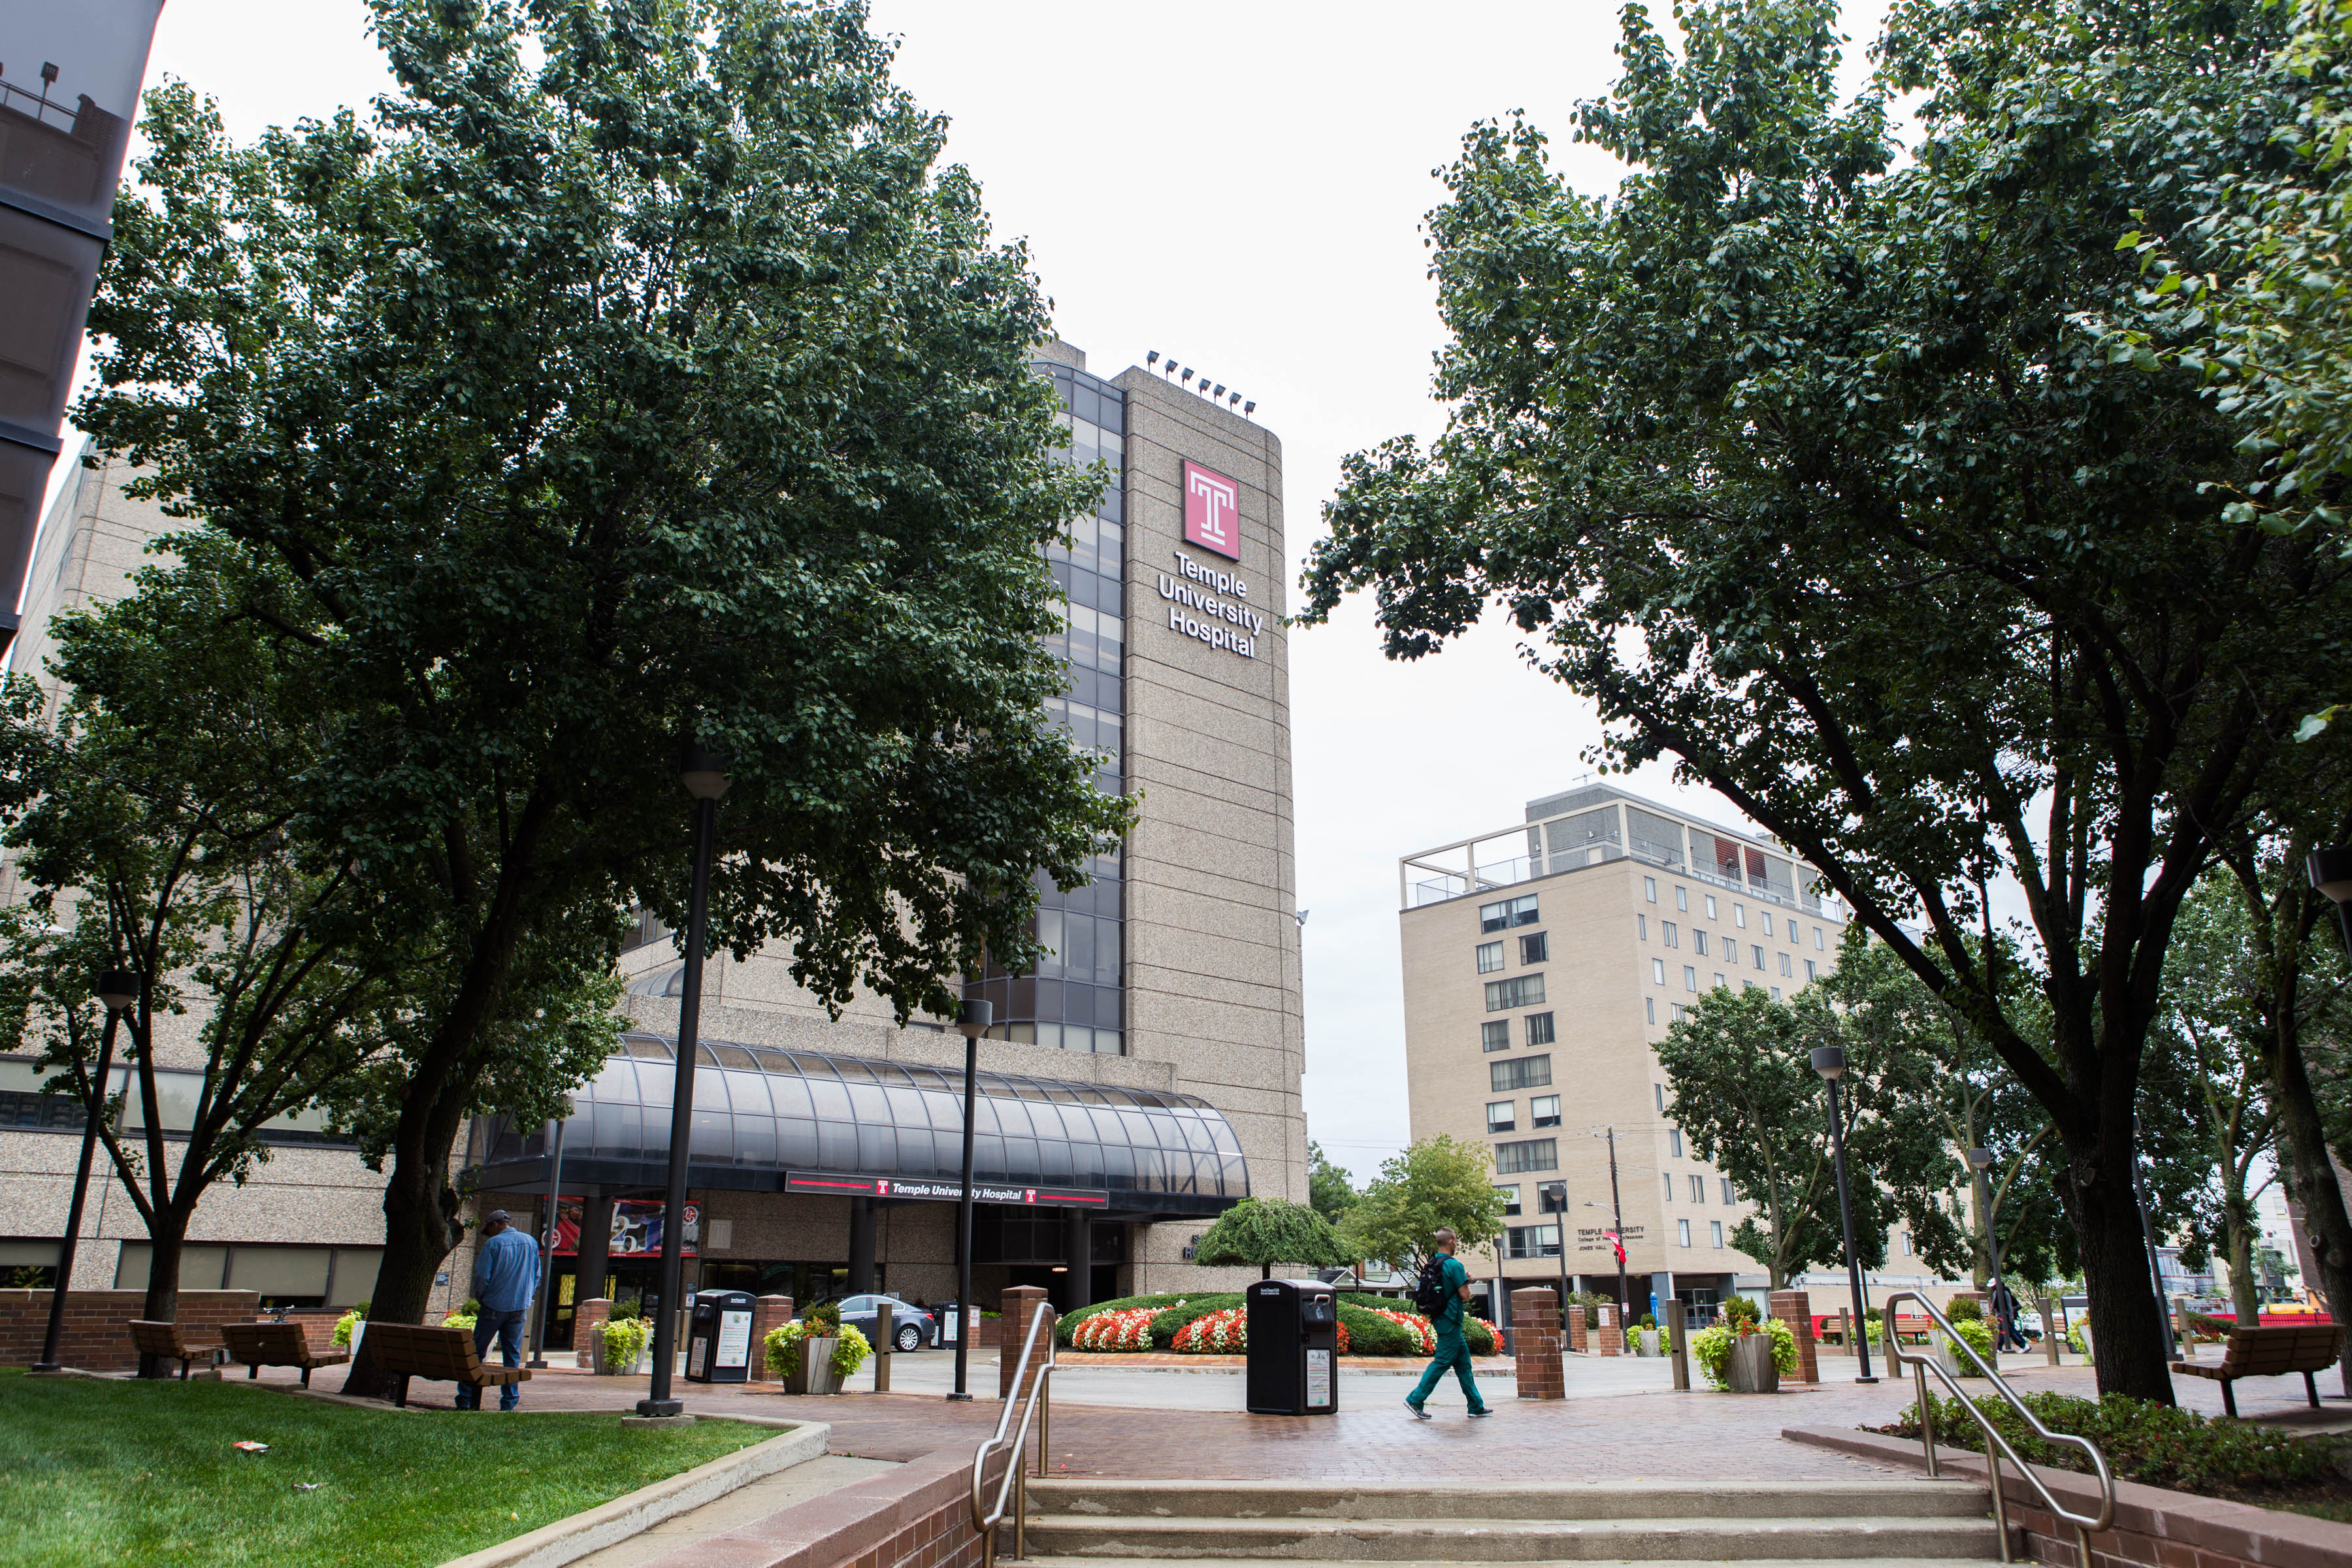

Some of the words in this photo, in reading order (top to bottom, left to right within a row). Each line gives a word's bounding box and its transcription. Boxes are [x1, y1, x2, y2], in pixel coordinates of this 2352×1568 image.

[1190, 470, 1234, 546] T
[1175, 551, 1247, 597] Temple
[1158, 574, 1263, 636] University
[1169, 607, 1255, 658] Hospital
[893, 1183, 930, 1195] Temple
[932, 1185, 981, 1199] Univerty
[983, 1188, 1022, 1201] Hospital
